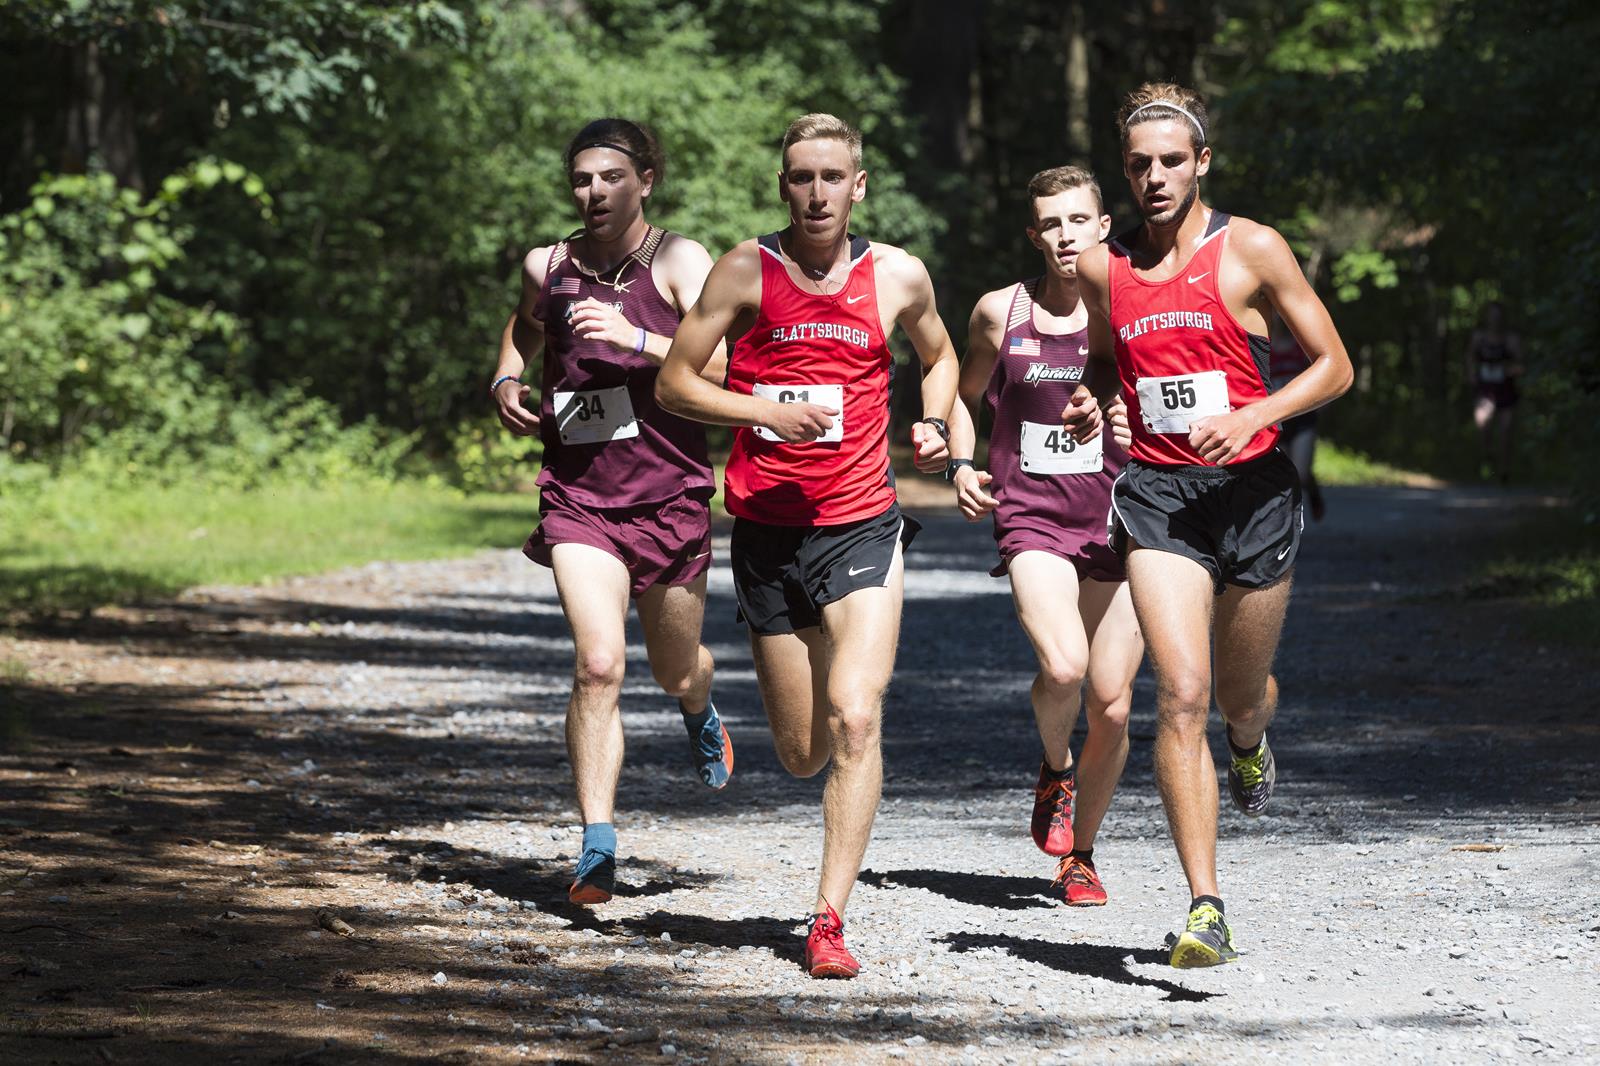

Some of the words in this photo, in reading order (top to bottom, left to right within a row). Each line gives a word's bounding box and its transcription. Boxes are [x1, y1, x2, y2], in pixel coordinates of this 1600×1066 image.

[772, 322, 869, 349] PLATTSBURGH
[1120, 311, 1214, 344] PLATTSBURGH
[574, 395, 605, 421] 34
[1160, 379, 1197, 410] 55
[1044, 430, 1076, 453] 43
